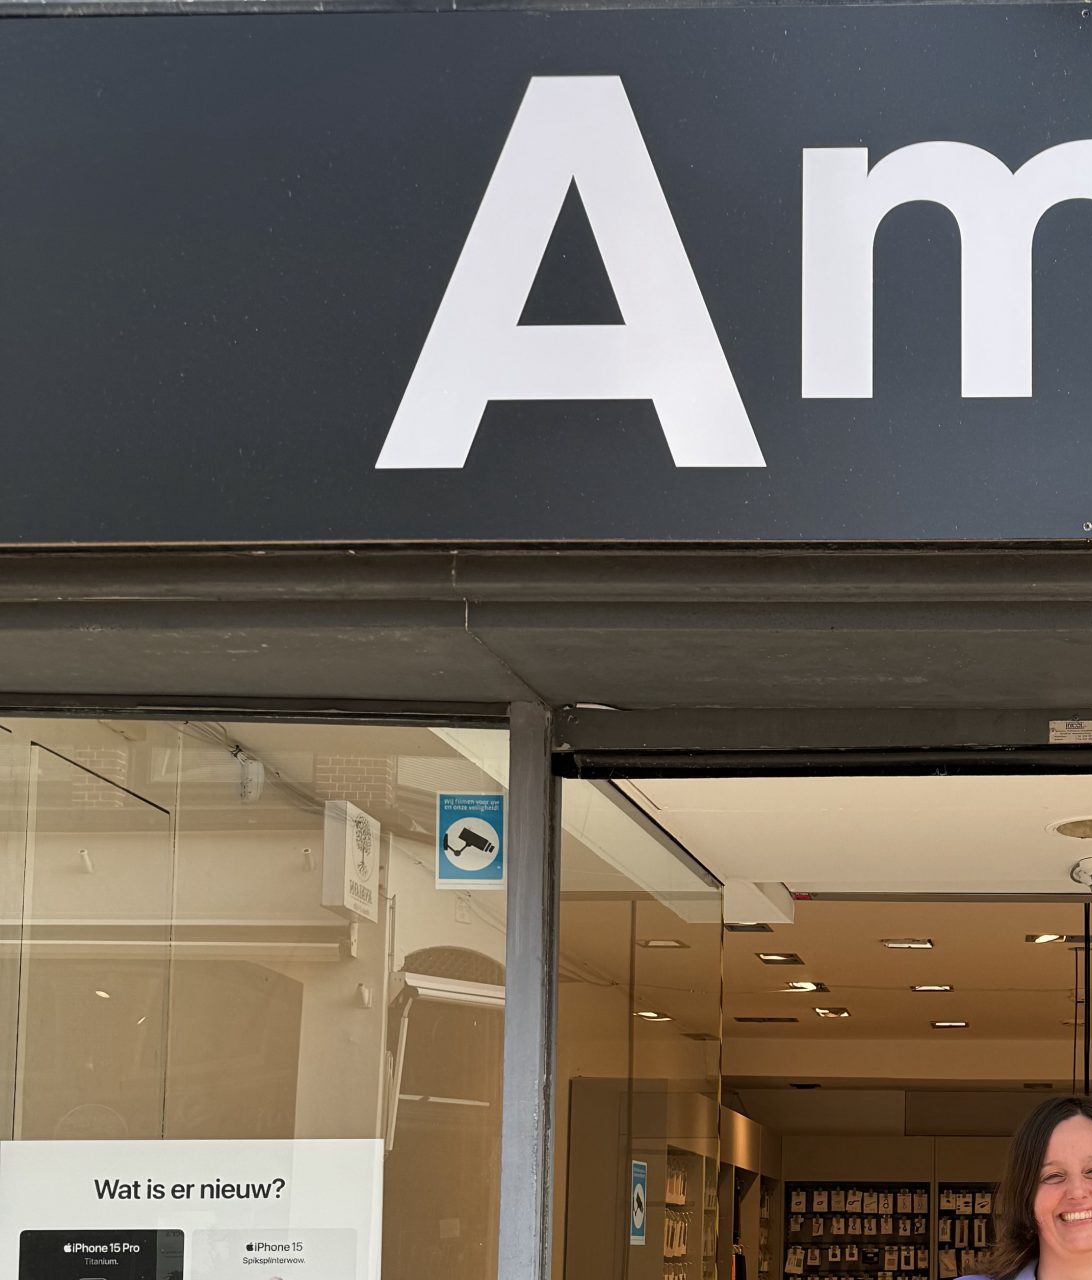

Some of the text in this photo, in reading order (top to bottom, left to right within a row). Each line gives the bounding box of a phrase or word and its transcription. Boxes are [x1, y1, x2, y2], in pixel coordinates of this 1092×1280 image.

[94, 1178, 286, 1200] Wat is er nieuw?
[72, 1242, 140, 1253] iPhone 15 Pro
[254, 1242, 303, 1252] iPhone 15
[84, 1257, 119, 1265] Titanium.
[242, 1256, 306, 1266] Spiksplinterwow.
